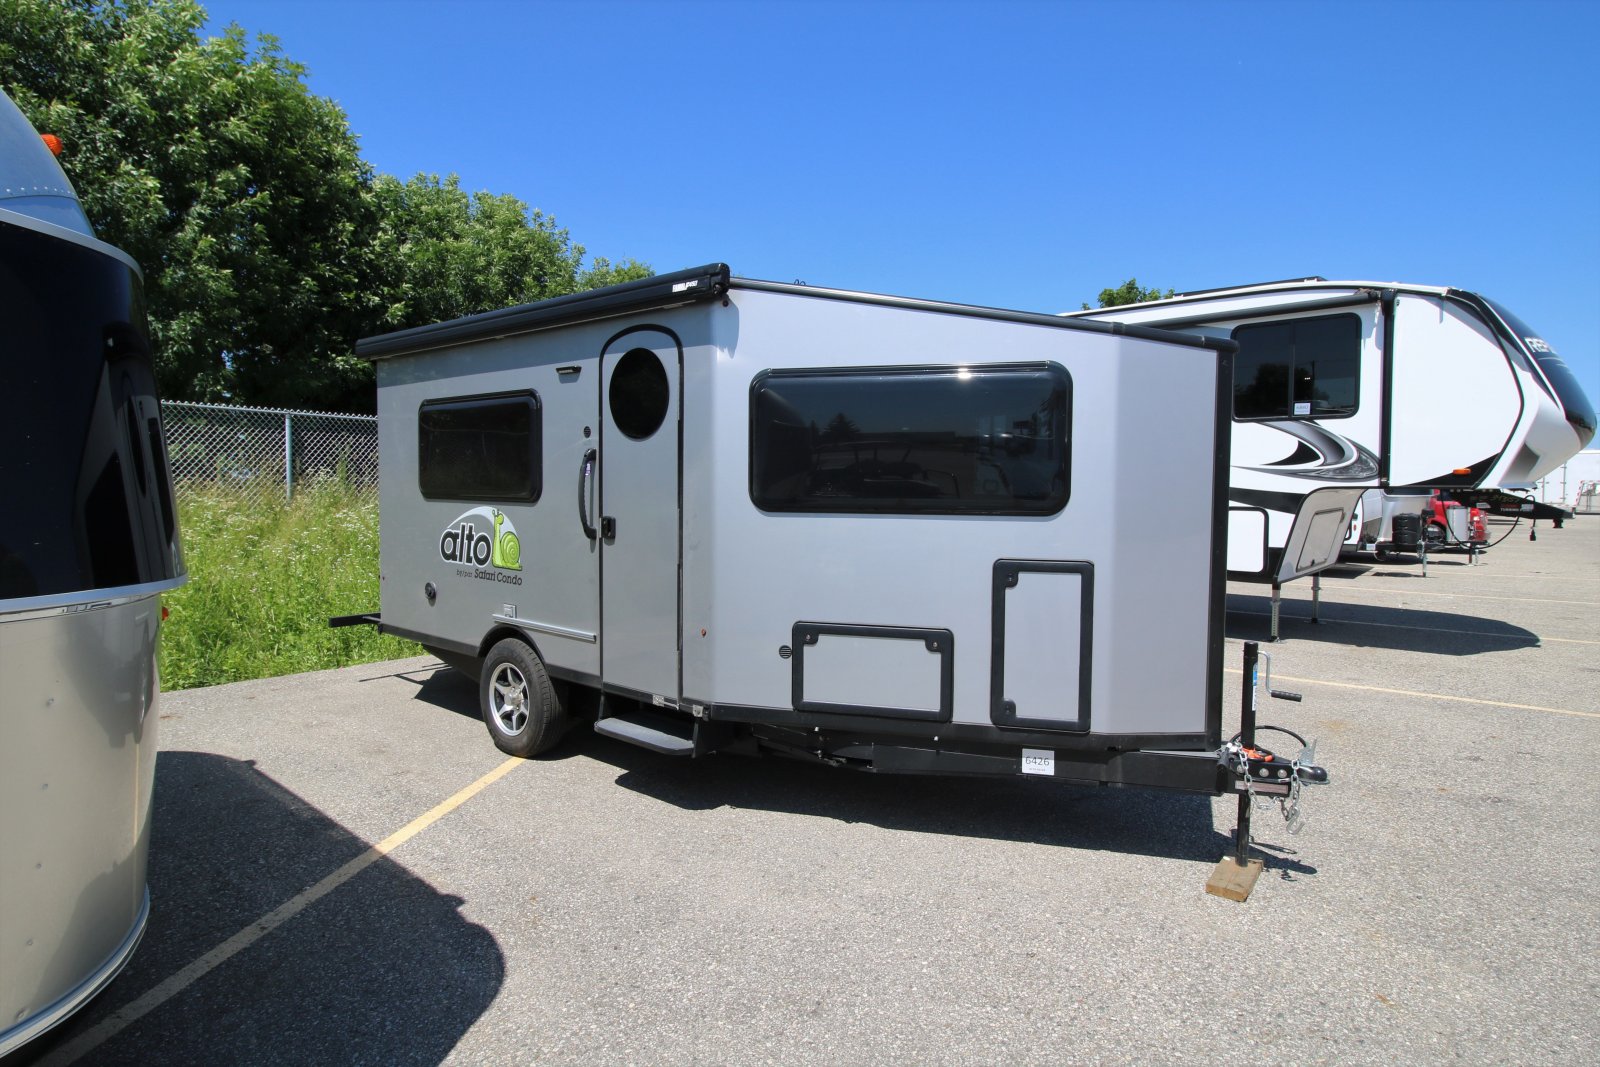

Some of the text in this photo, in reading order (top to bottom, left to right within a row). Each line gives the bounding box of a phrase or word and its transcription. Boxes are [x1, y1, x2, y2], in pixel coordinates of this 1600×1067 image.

[440, 522, 492, 567] alto
[474, 568, 496, 582] Safari
[496, 572, 523, 586] Condo
[1025, 756, 1050, 767] 6426
